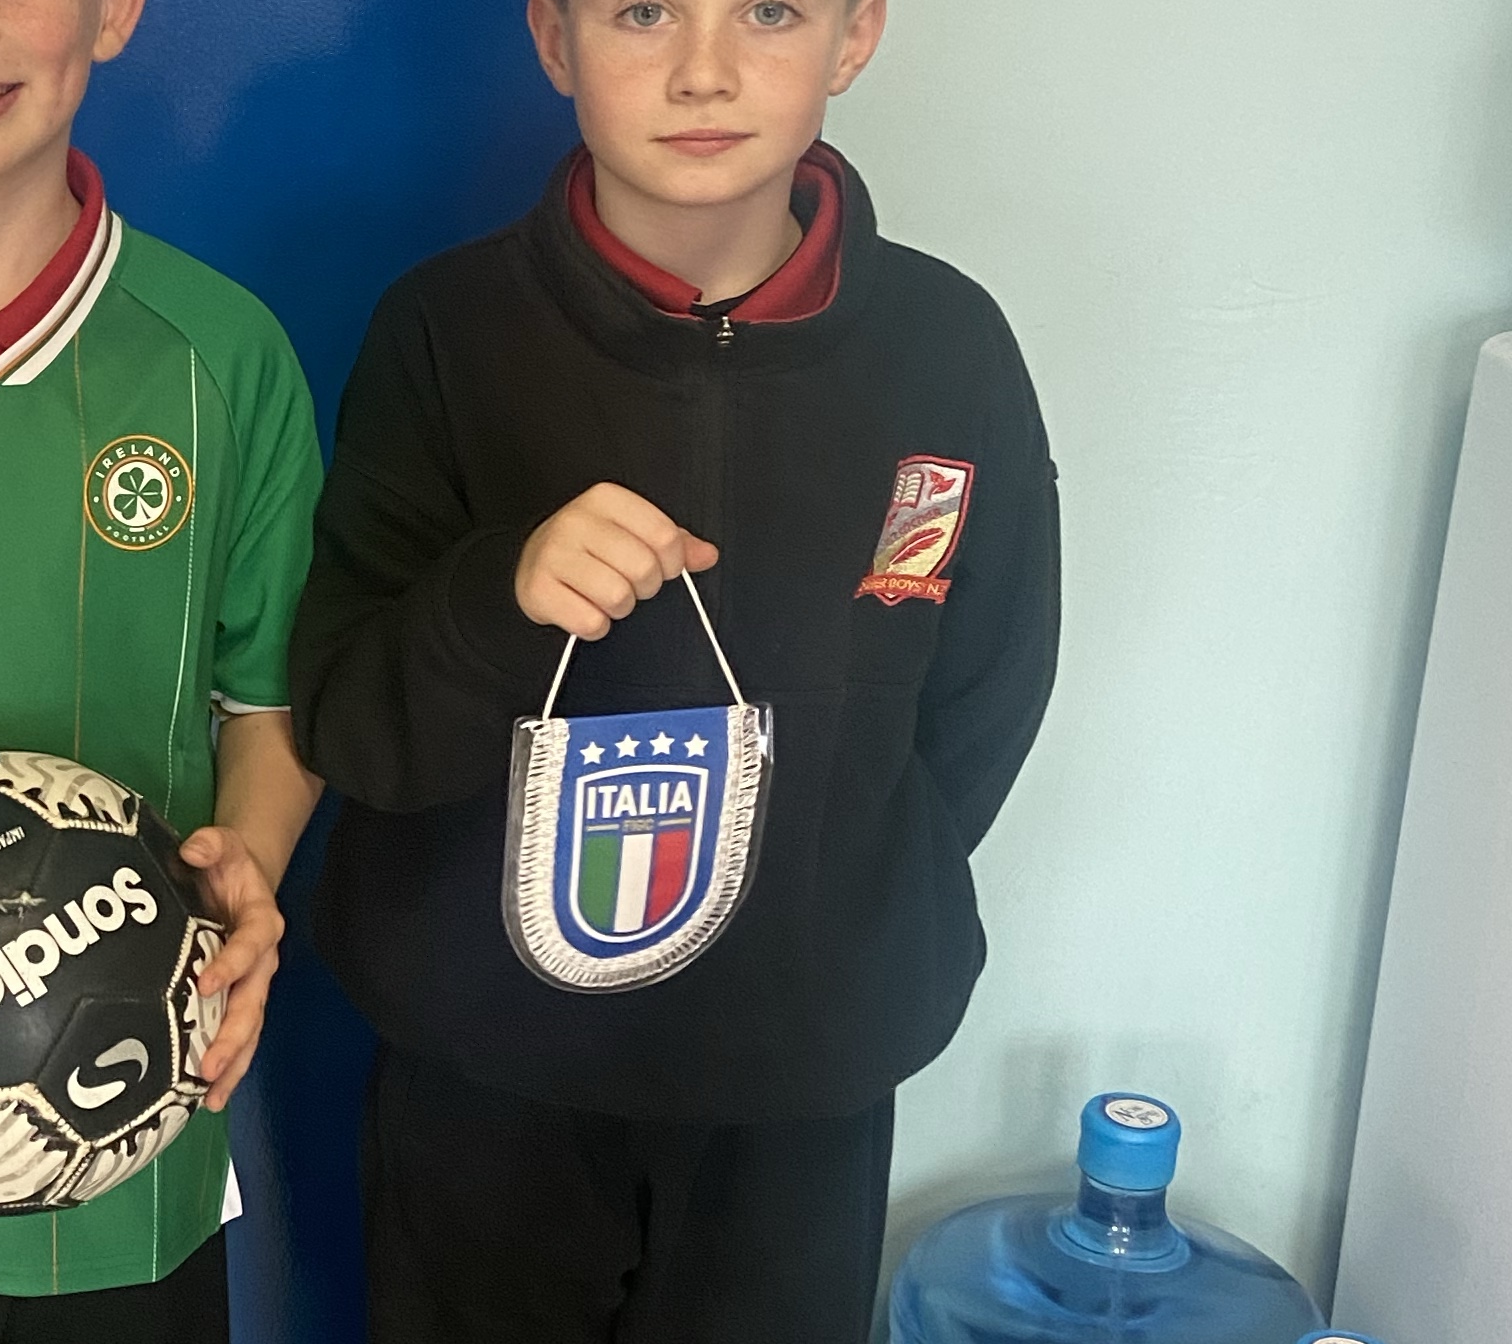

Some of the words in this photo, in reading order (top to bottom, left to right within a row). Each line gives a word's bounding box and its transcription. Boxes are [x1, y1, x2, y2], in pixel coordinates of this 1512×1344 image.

[95, 444, 180, 479] IRELAND
[106, 525, 169, 543] FOOTBALL
[586, 781, 693, 819] ITALIA
